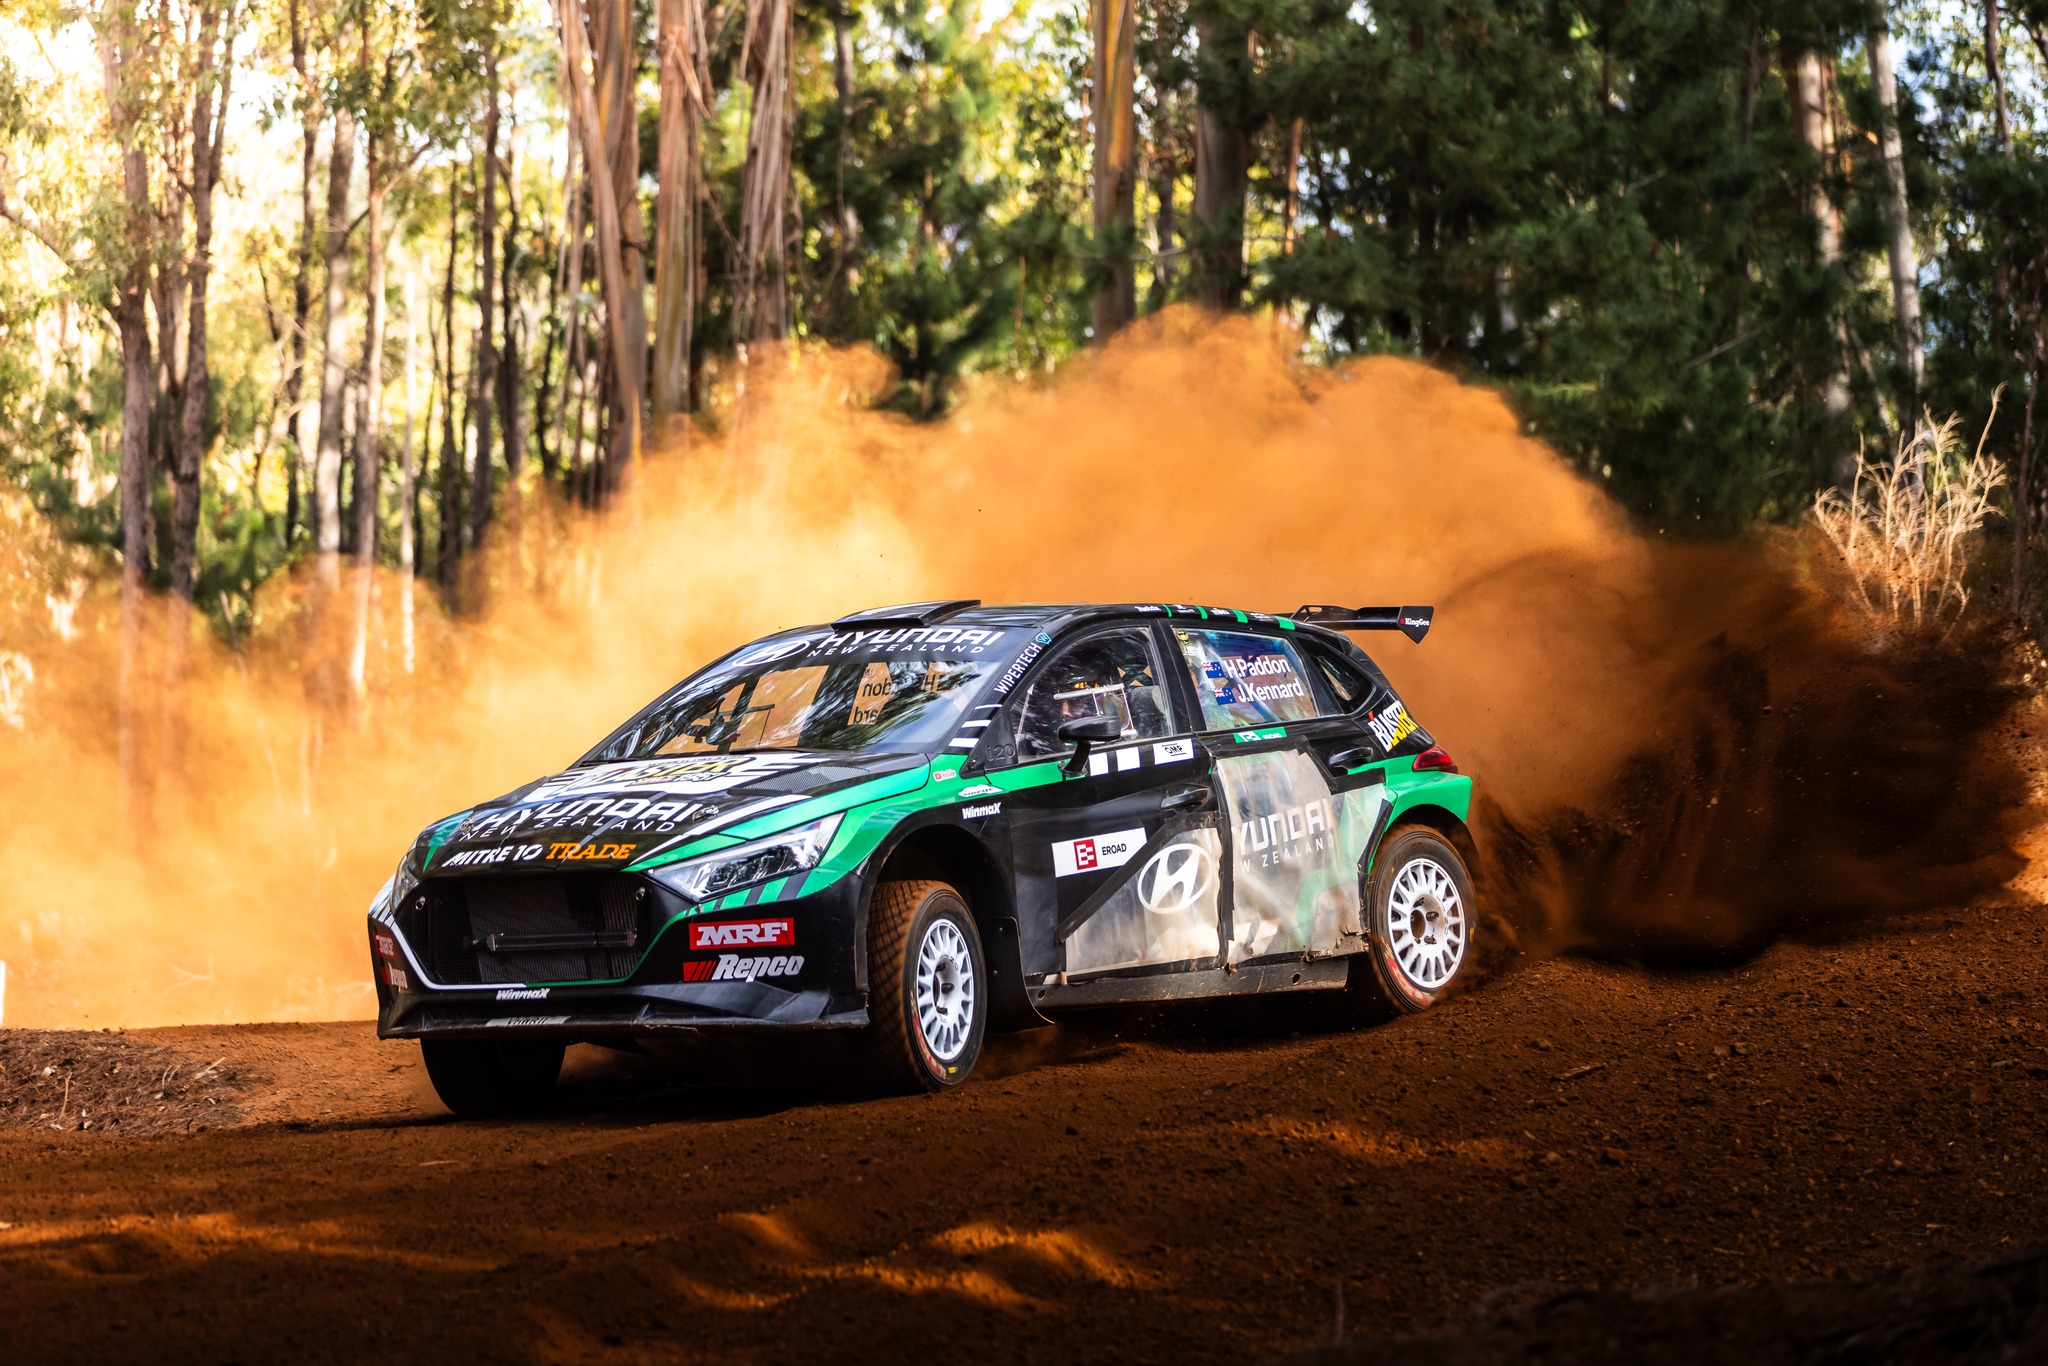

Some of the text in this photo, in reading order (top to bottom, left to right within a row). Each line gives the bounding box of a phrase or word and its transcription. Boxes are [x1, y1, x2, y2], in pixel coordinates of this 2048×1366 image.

[1405, 617, 1430, 627] KingGee
[806, 643, 985, 658] NEW ZEALAND
[817, 628, 1006, 649] HYUNDAI
[993, 642, 1043, 694] WIPERTECH
[1222, 655, 1291, 679] H.Paddon
[1237, 678, 1304, 703] J.Kennard
[1367, 700, 1419, 753] BLASTER
[1164, 745, 1183, 755] OMP
[458, 815, 676, 842] NEW ZEALAND
[471, 799, 705, 833] HYUNDAI
[1231, 798, 1333, 856] YUNDAI
[441, 841, 637, 868] MITRE 10 TRADE
[1101, 843, 1127, 856] EROAD
[696, 922, 788, 946] MRF
[711, 953, 805, 983] Repco
